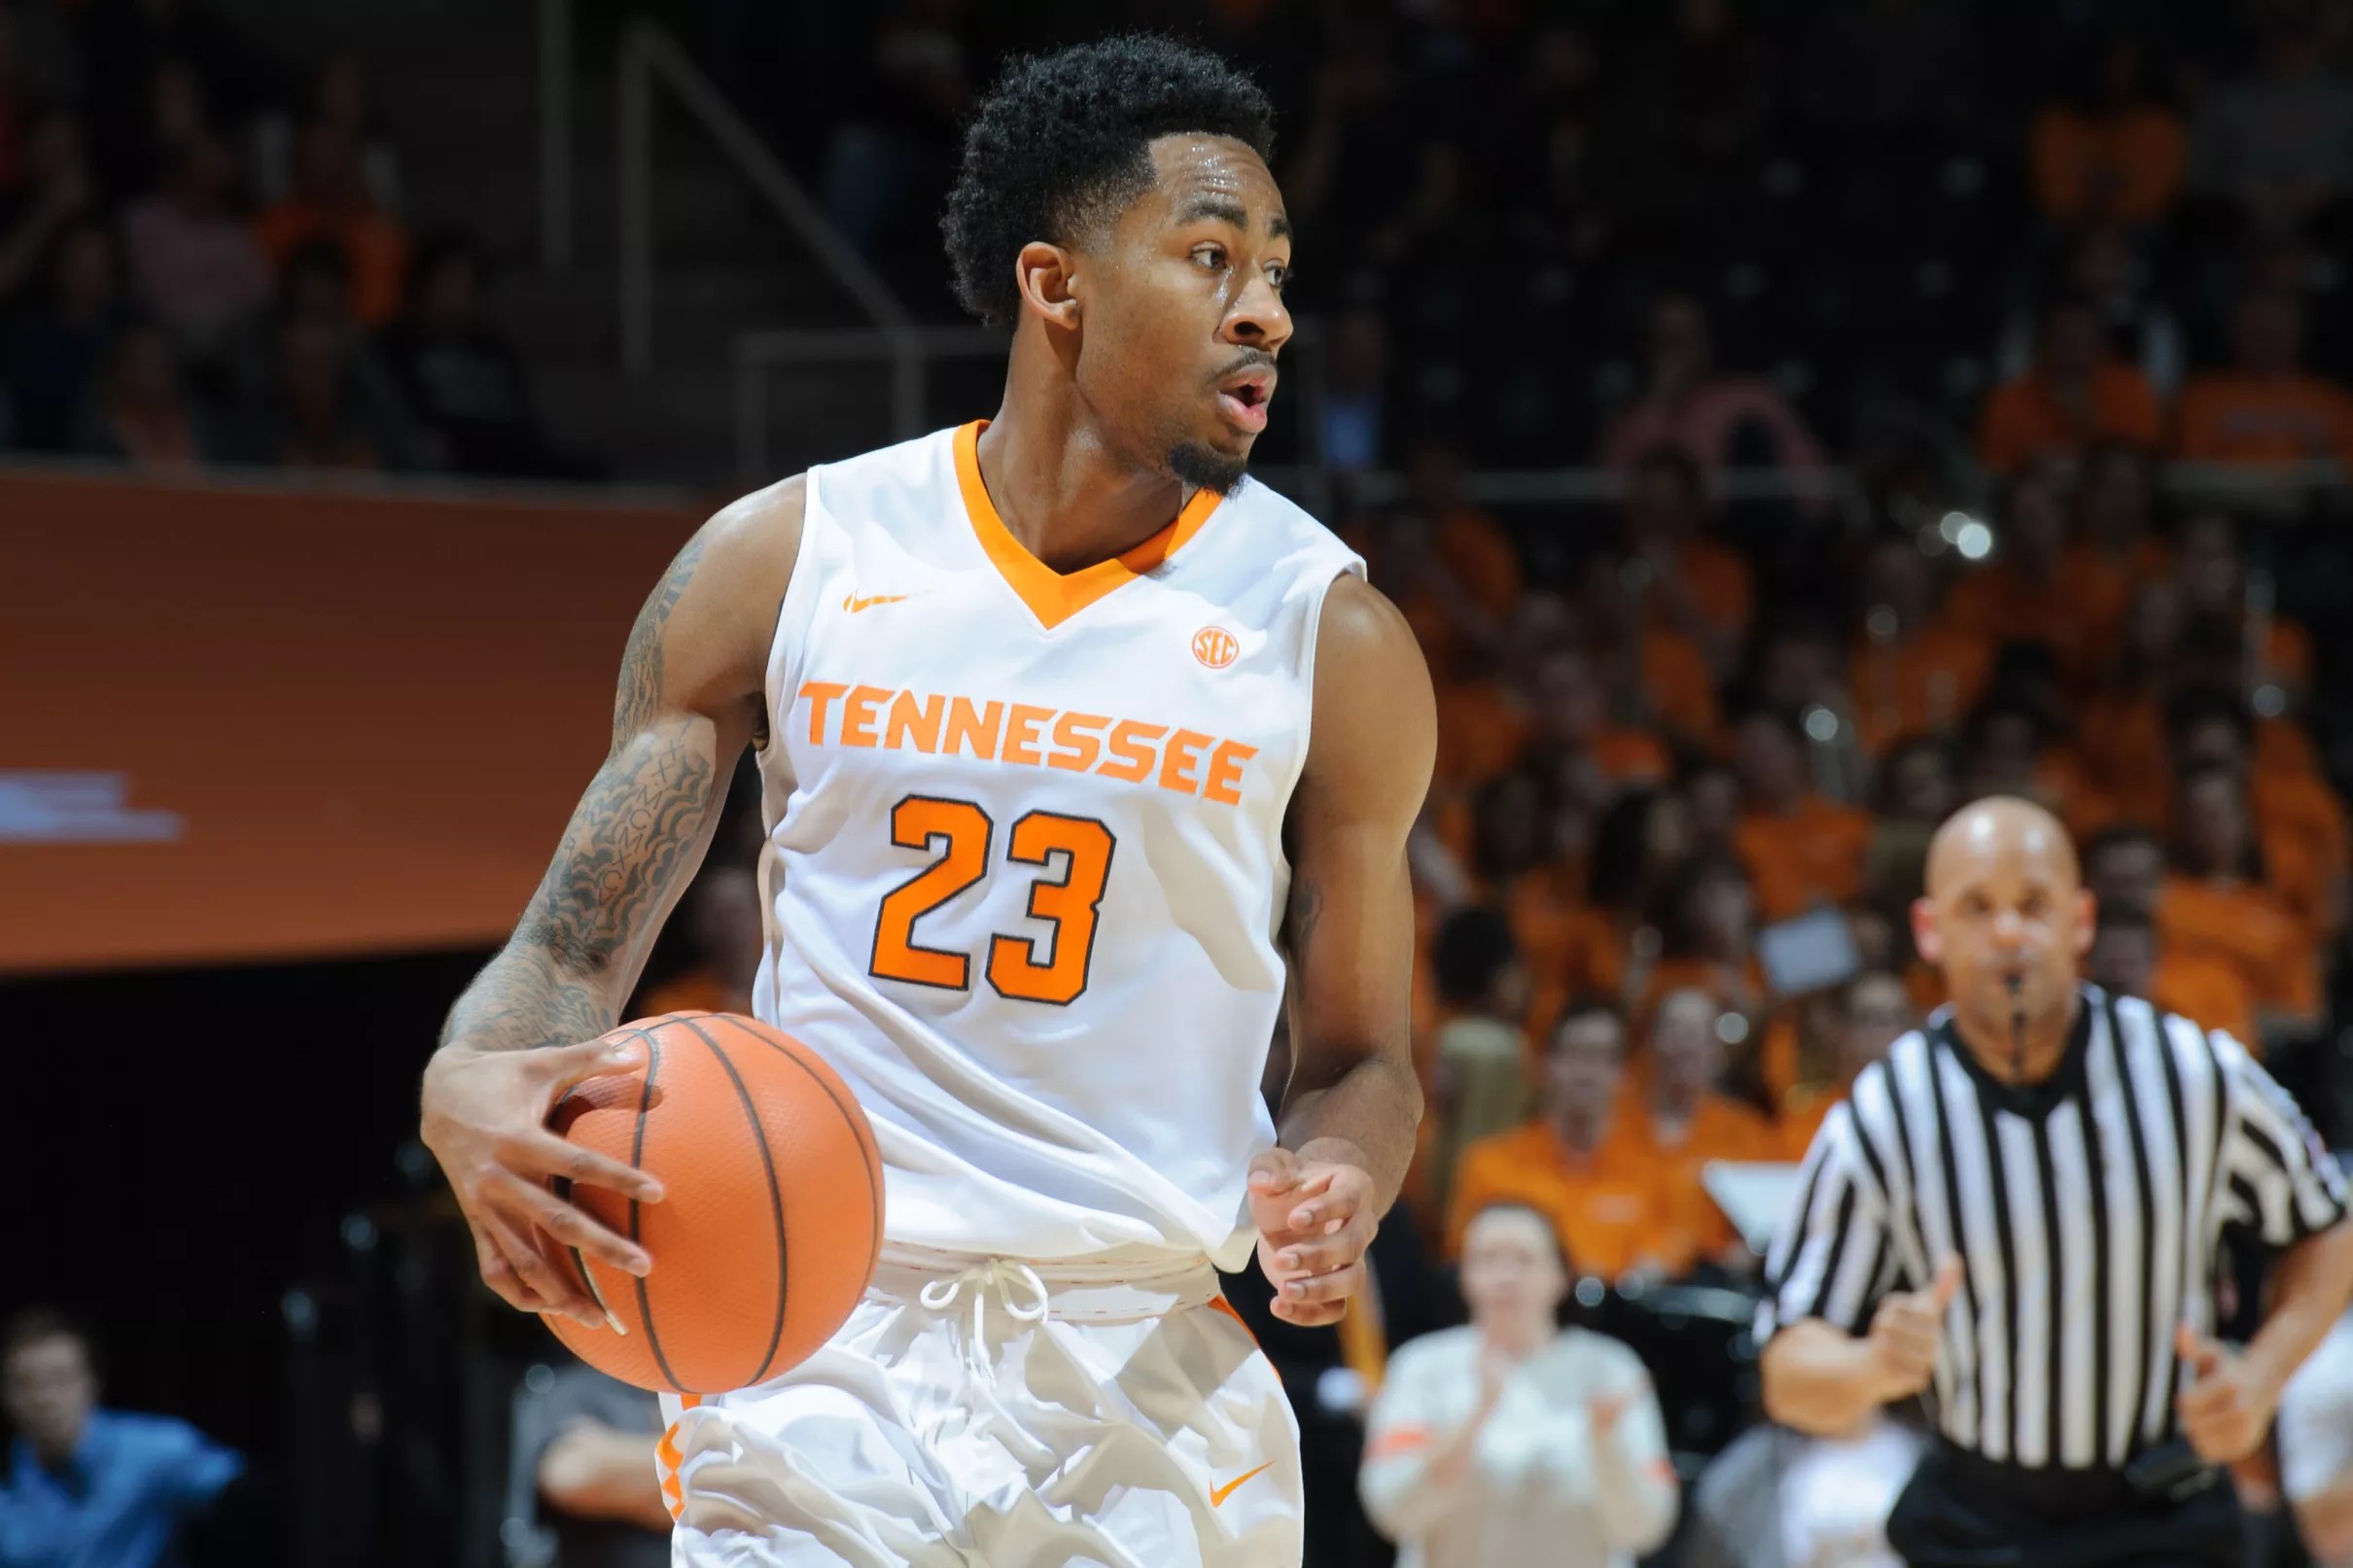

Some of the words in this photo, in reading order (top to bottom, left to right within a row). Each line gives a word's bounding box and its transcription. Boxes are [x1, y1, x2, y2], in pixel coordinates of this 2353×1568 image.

[1195, 629, 1235, 666] SEC
[798, 680, 1259, 806] TENNESSEE
[868, 793, 1117, 1006] 23
